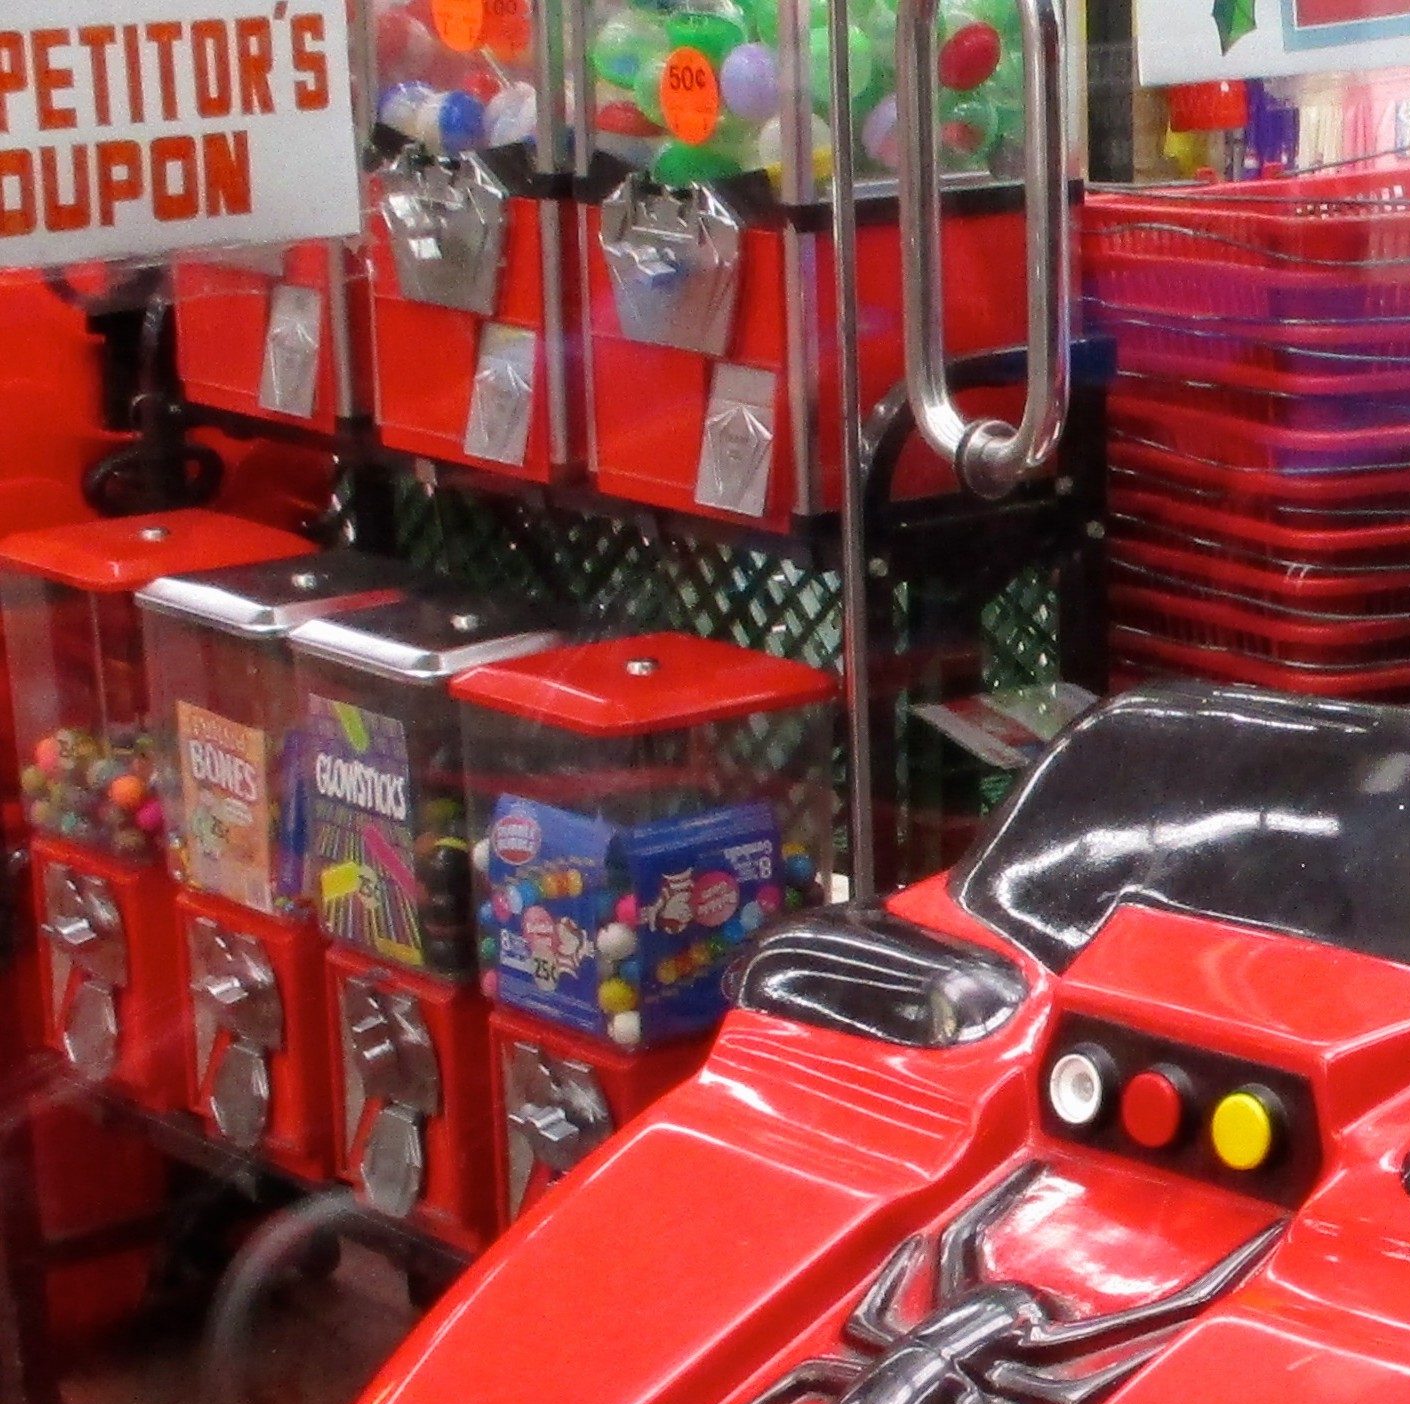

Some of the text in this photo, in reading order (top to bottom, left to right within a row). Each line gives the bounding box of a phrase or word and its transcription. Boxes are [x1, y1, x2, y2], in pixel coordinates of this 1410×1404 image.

[0, 1, 330, 133] PETITOR'S
[669, 65, 706, 91] 50¢
[0, 130, 252, 238] OUPON
[188, 739, 258, 801] BONES
[316, 752, 407, 821] GLOWSTICKS
